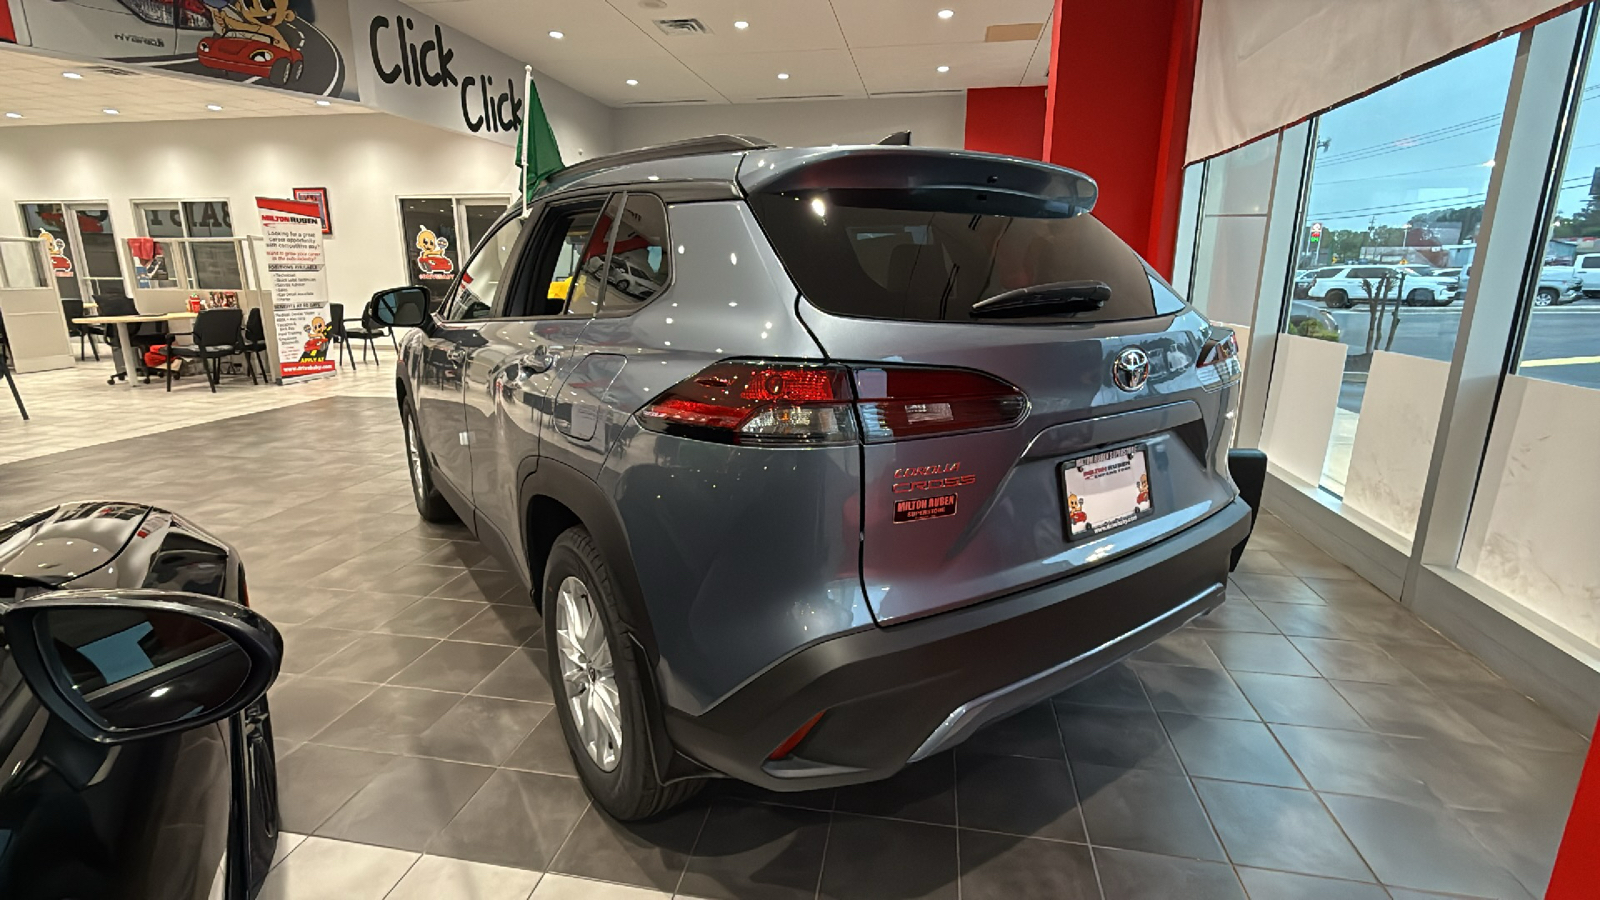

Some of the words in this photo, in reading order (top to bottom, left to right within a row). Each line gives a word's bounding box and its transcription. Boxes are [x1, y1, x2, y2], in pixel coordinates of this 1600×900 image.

[370, 15, 458, 87] Click
[461, 74, 522, 132] Click
[894, 461, 960, 478] COROLLA
[892, 474, 976, 493] CROSS
[897, 500, 927, 512] MILTON
[928, 495, 954, 508] RUBEN
